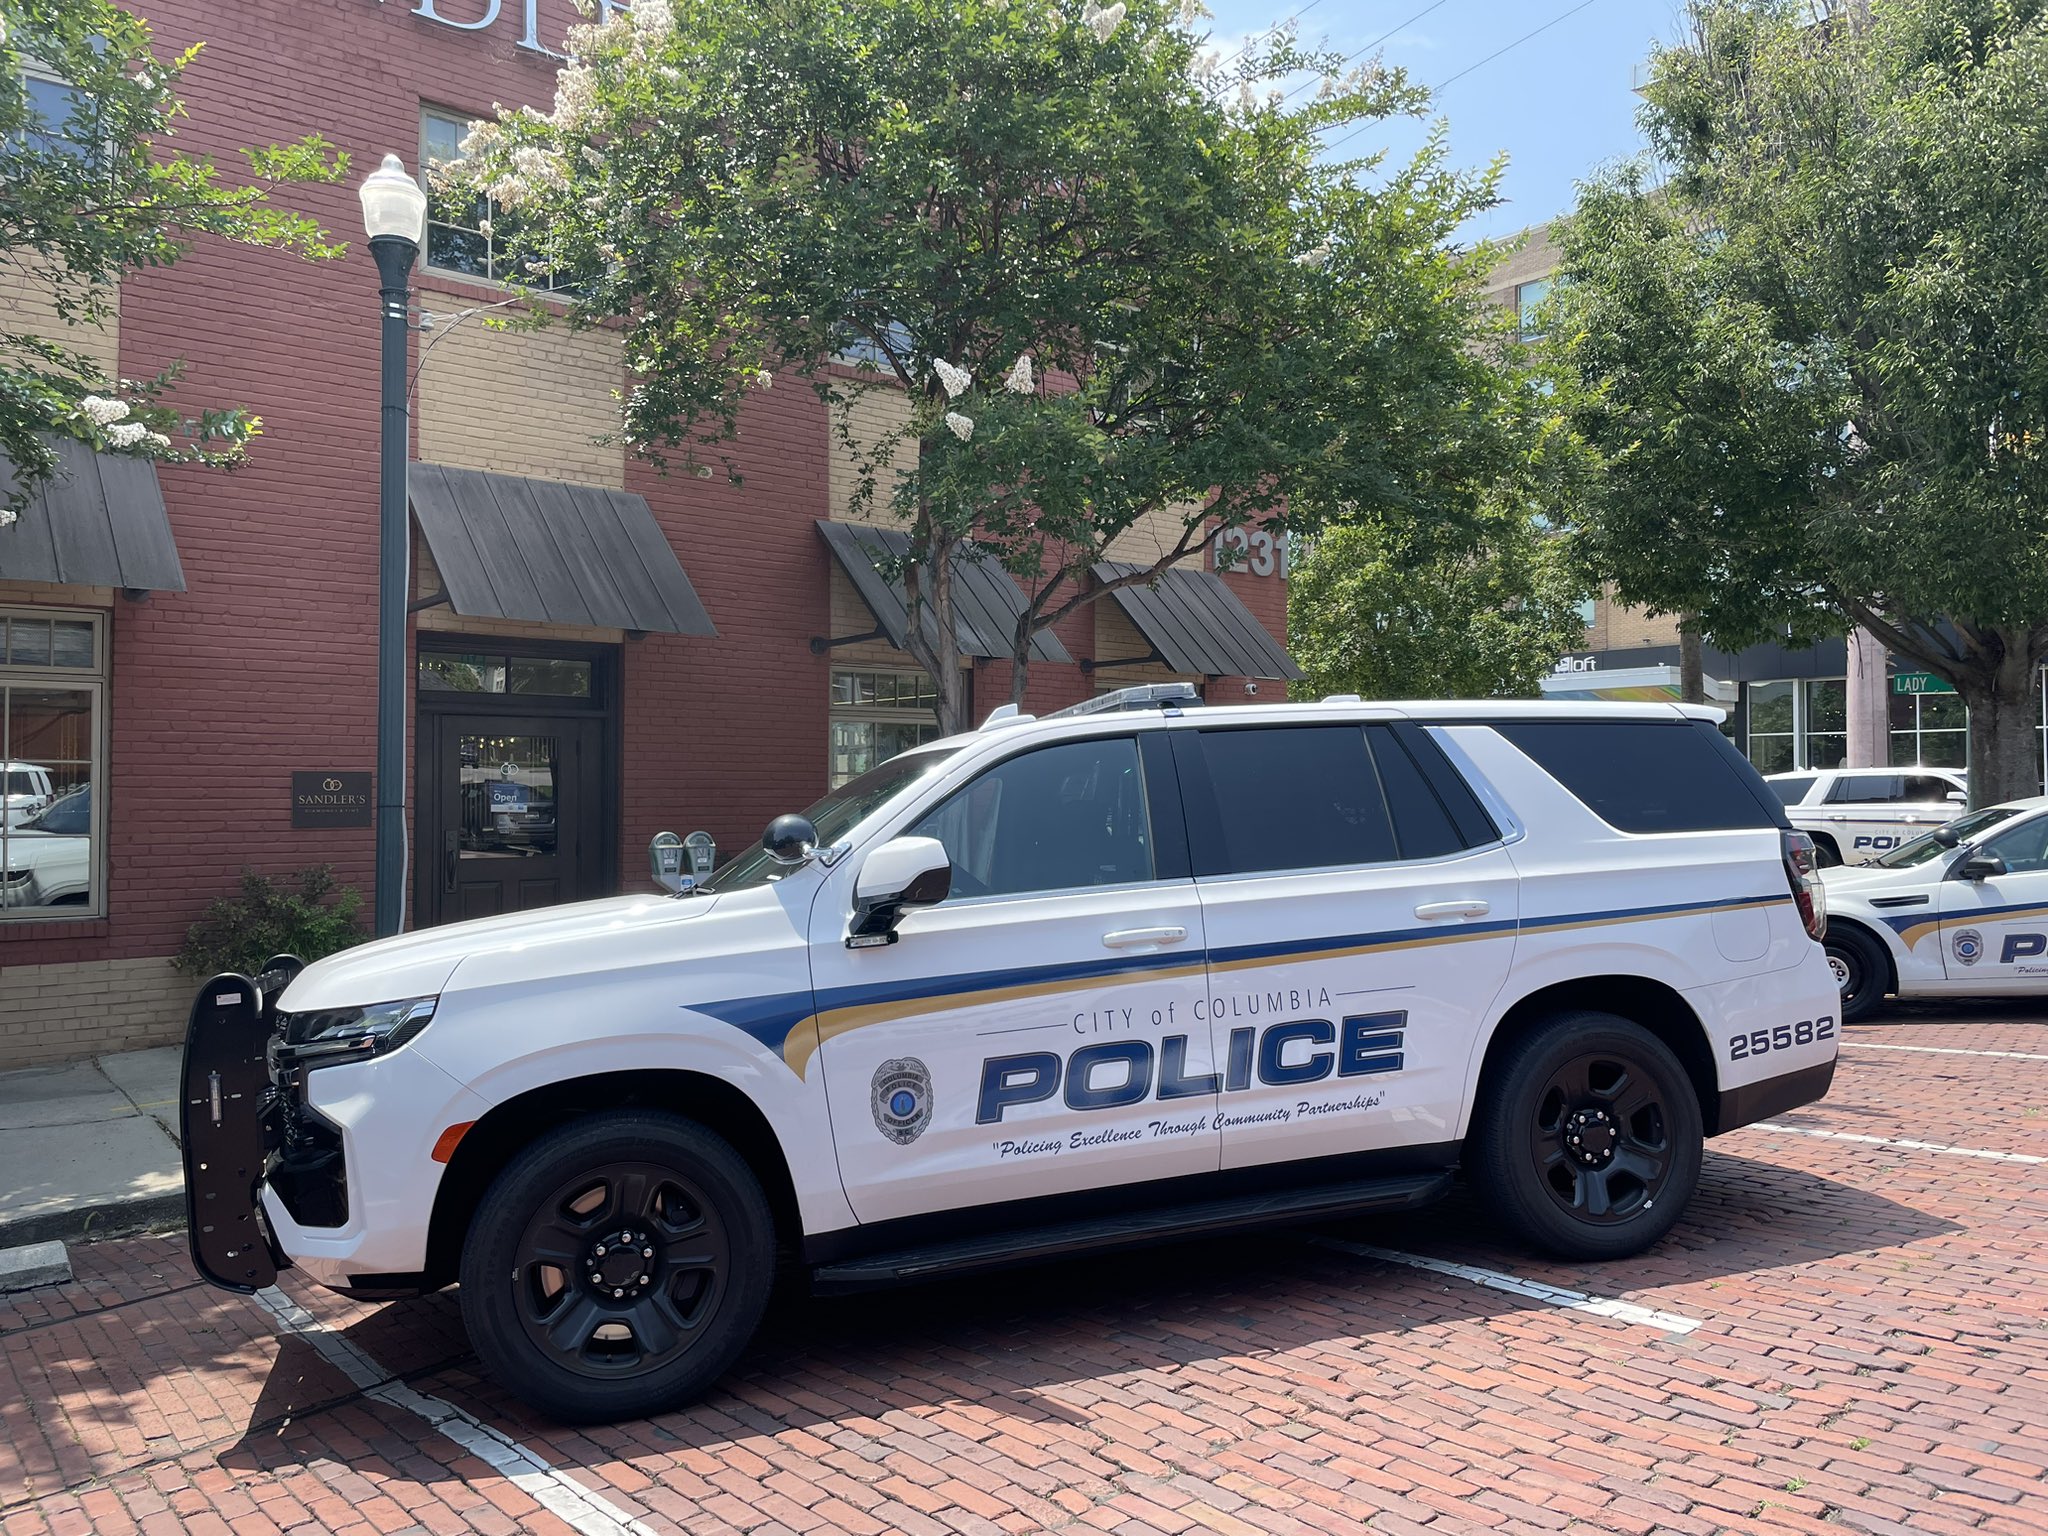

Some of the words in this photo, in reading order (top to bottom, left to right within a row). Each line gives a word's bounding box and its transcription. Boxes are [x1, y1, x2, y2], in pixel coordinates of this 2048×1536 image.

[1897, 677, 1927, 692] LADY
[299, 794, 366, 805] SANDLER'S
[493, 793, 517, 802] Open
[1853, 836, 1901, 849] POL
[1073, 1008, 1132, 1034] CITY
[1151, 1001, 1175, 1026] of
[1194, 987, 1331, 1021] COLUMBIA
[1729, 1016, 1834, 1061] 25582
[975, 1009, 1408, 1125] POLICE
[883, 1072, 919, 1084] COLUMBIA
[886, 1080, 918, 1091] POLICE
[887, 1113, 921, 1125] OFFICER
[993, 1138, 1062, 1158] "Policing
[1069, 1128, 1142, 1149] Excellence
[1148, 1116, 1206, 1137] Through
[1212, 1108, 1291, 1131] Community
[1296, 1090, 1385, 1118] Partnerships"
